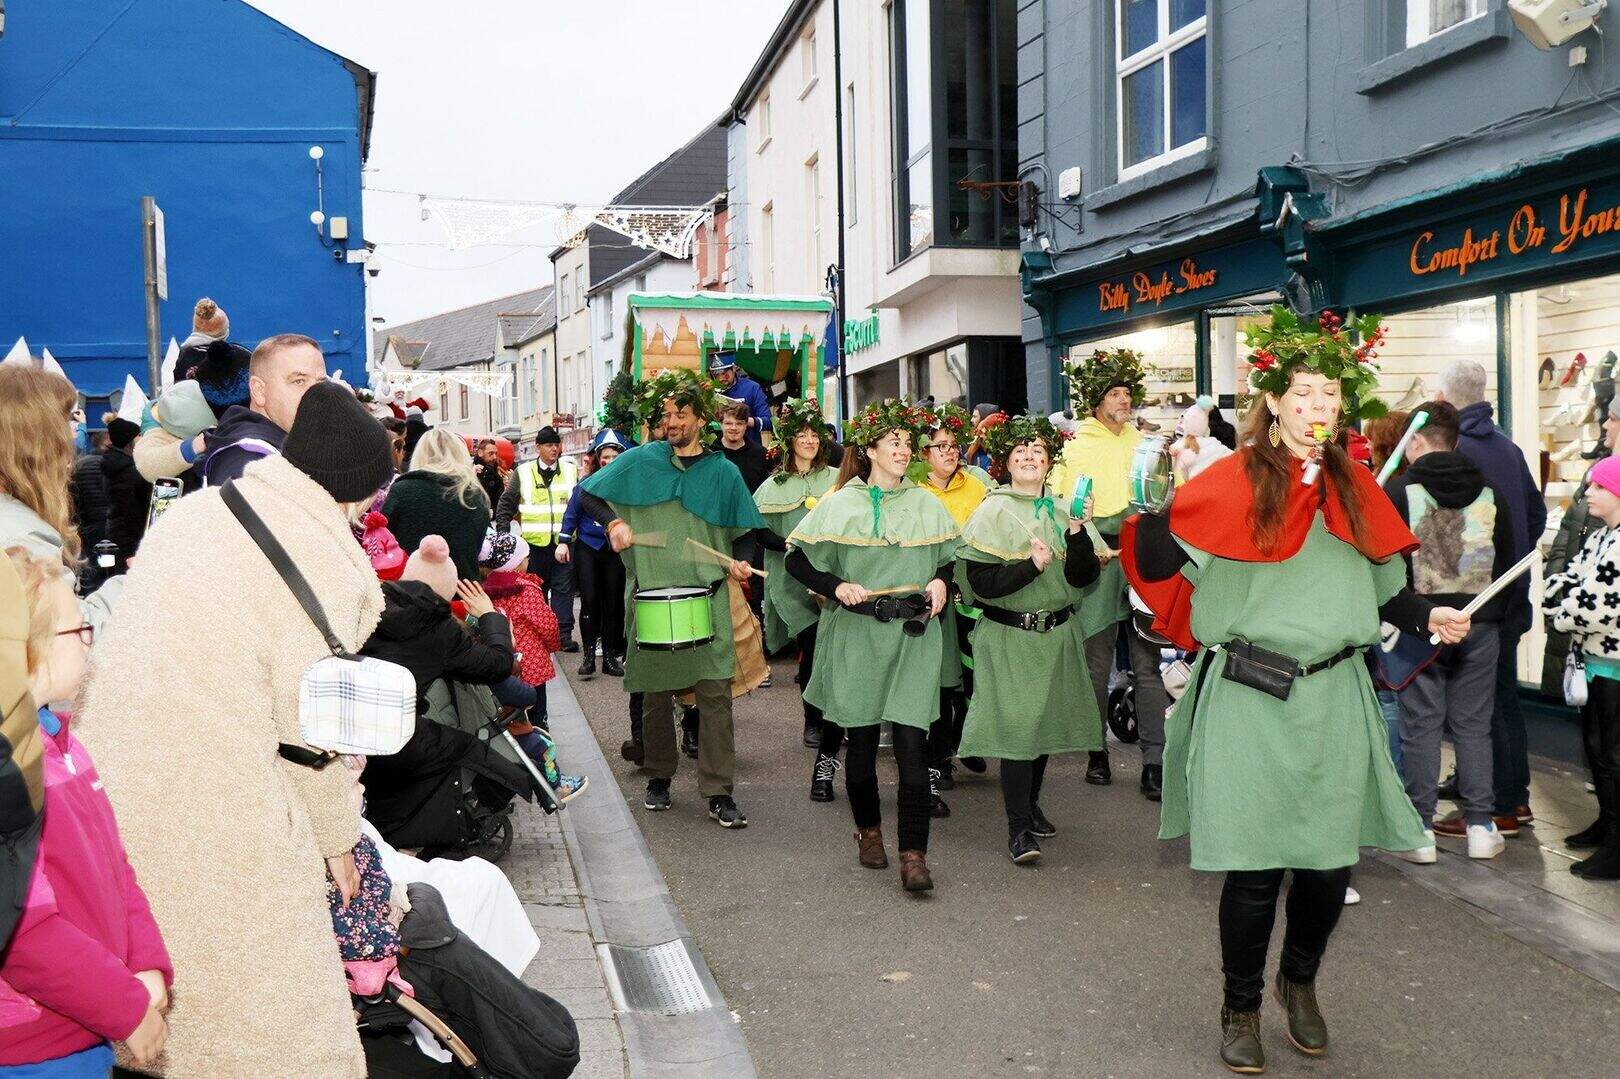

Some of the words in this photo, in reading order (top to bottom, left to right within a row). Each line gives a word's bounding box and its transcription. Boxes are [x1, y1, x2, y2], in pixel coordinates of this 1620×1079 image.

[1411, 228, 1500, 276] Comfort
[1507, 203, 1546, 255] On
[1099, 282, 1131, 313] Billy
[1133, 271, 1174, 306] Doyle
[1175, 258, 1217, 294] Shoes
